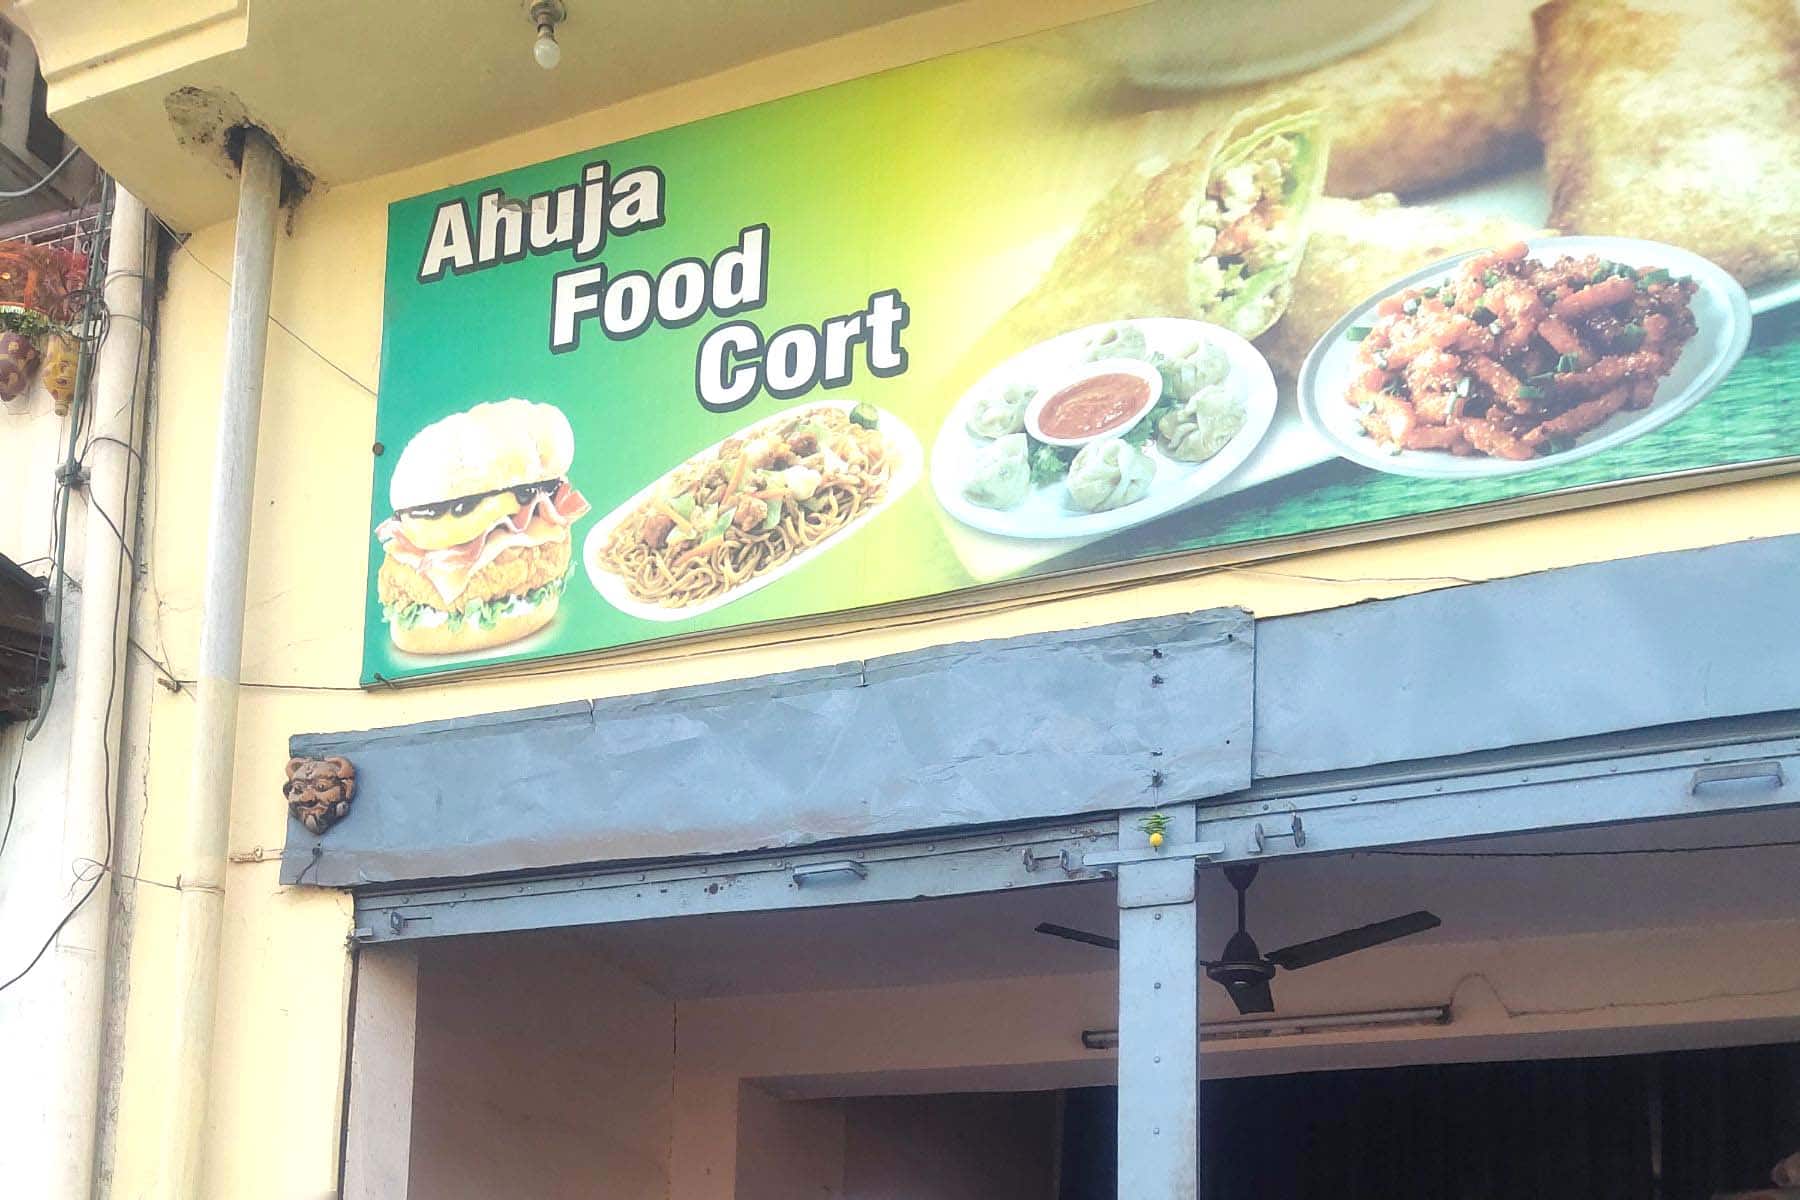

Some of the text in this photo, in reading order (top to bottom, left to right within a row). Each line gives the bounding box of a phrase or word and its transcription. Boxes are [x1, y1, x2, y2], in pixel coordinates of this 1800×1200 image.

[418, 160, 665, 284] Ahuja
[550, 224, 769, 354] Food
[696, 288, 909, 413] Cort
